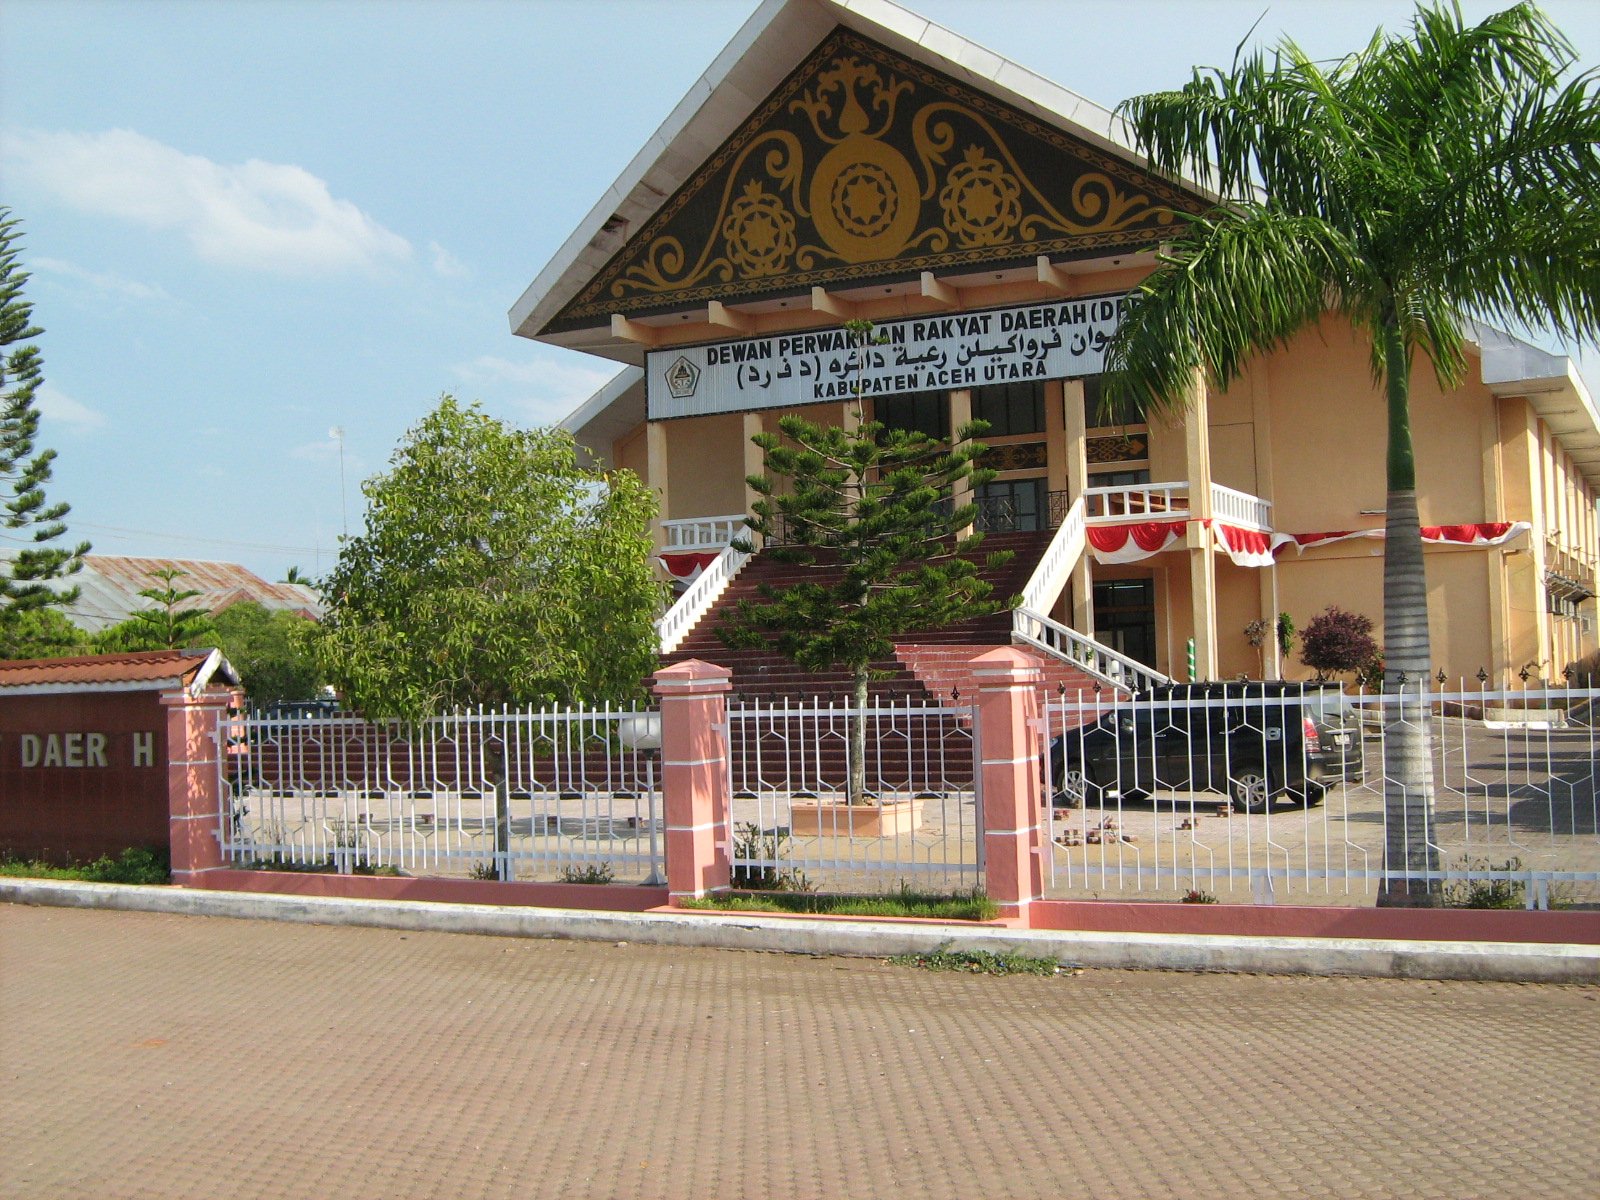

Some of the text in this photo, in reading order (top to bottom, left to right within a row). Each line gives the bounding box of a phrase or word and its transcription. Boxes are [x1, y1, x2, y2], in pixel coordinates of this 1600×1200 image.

[707, 340, 771, 366] DEWAN
[779, 325, 905, 357] PERWAKILAN
[913, 315, 992, 342] RAKYAT
[814, 360, 1047, 398] KABUPATEN ACEH UTARA
